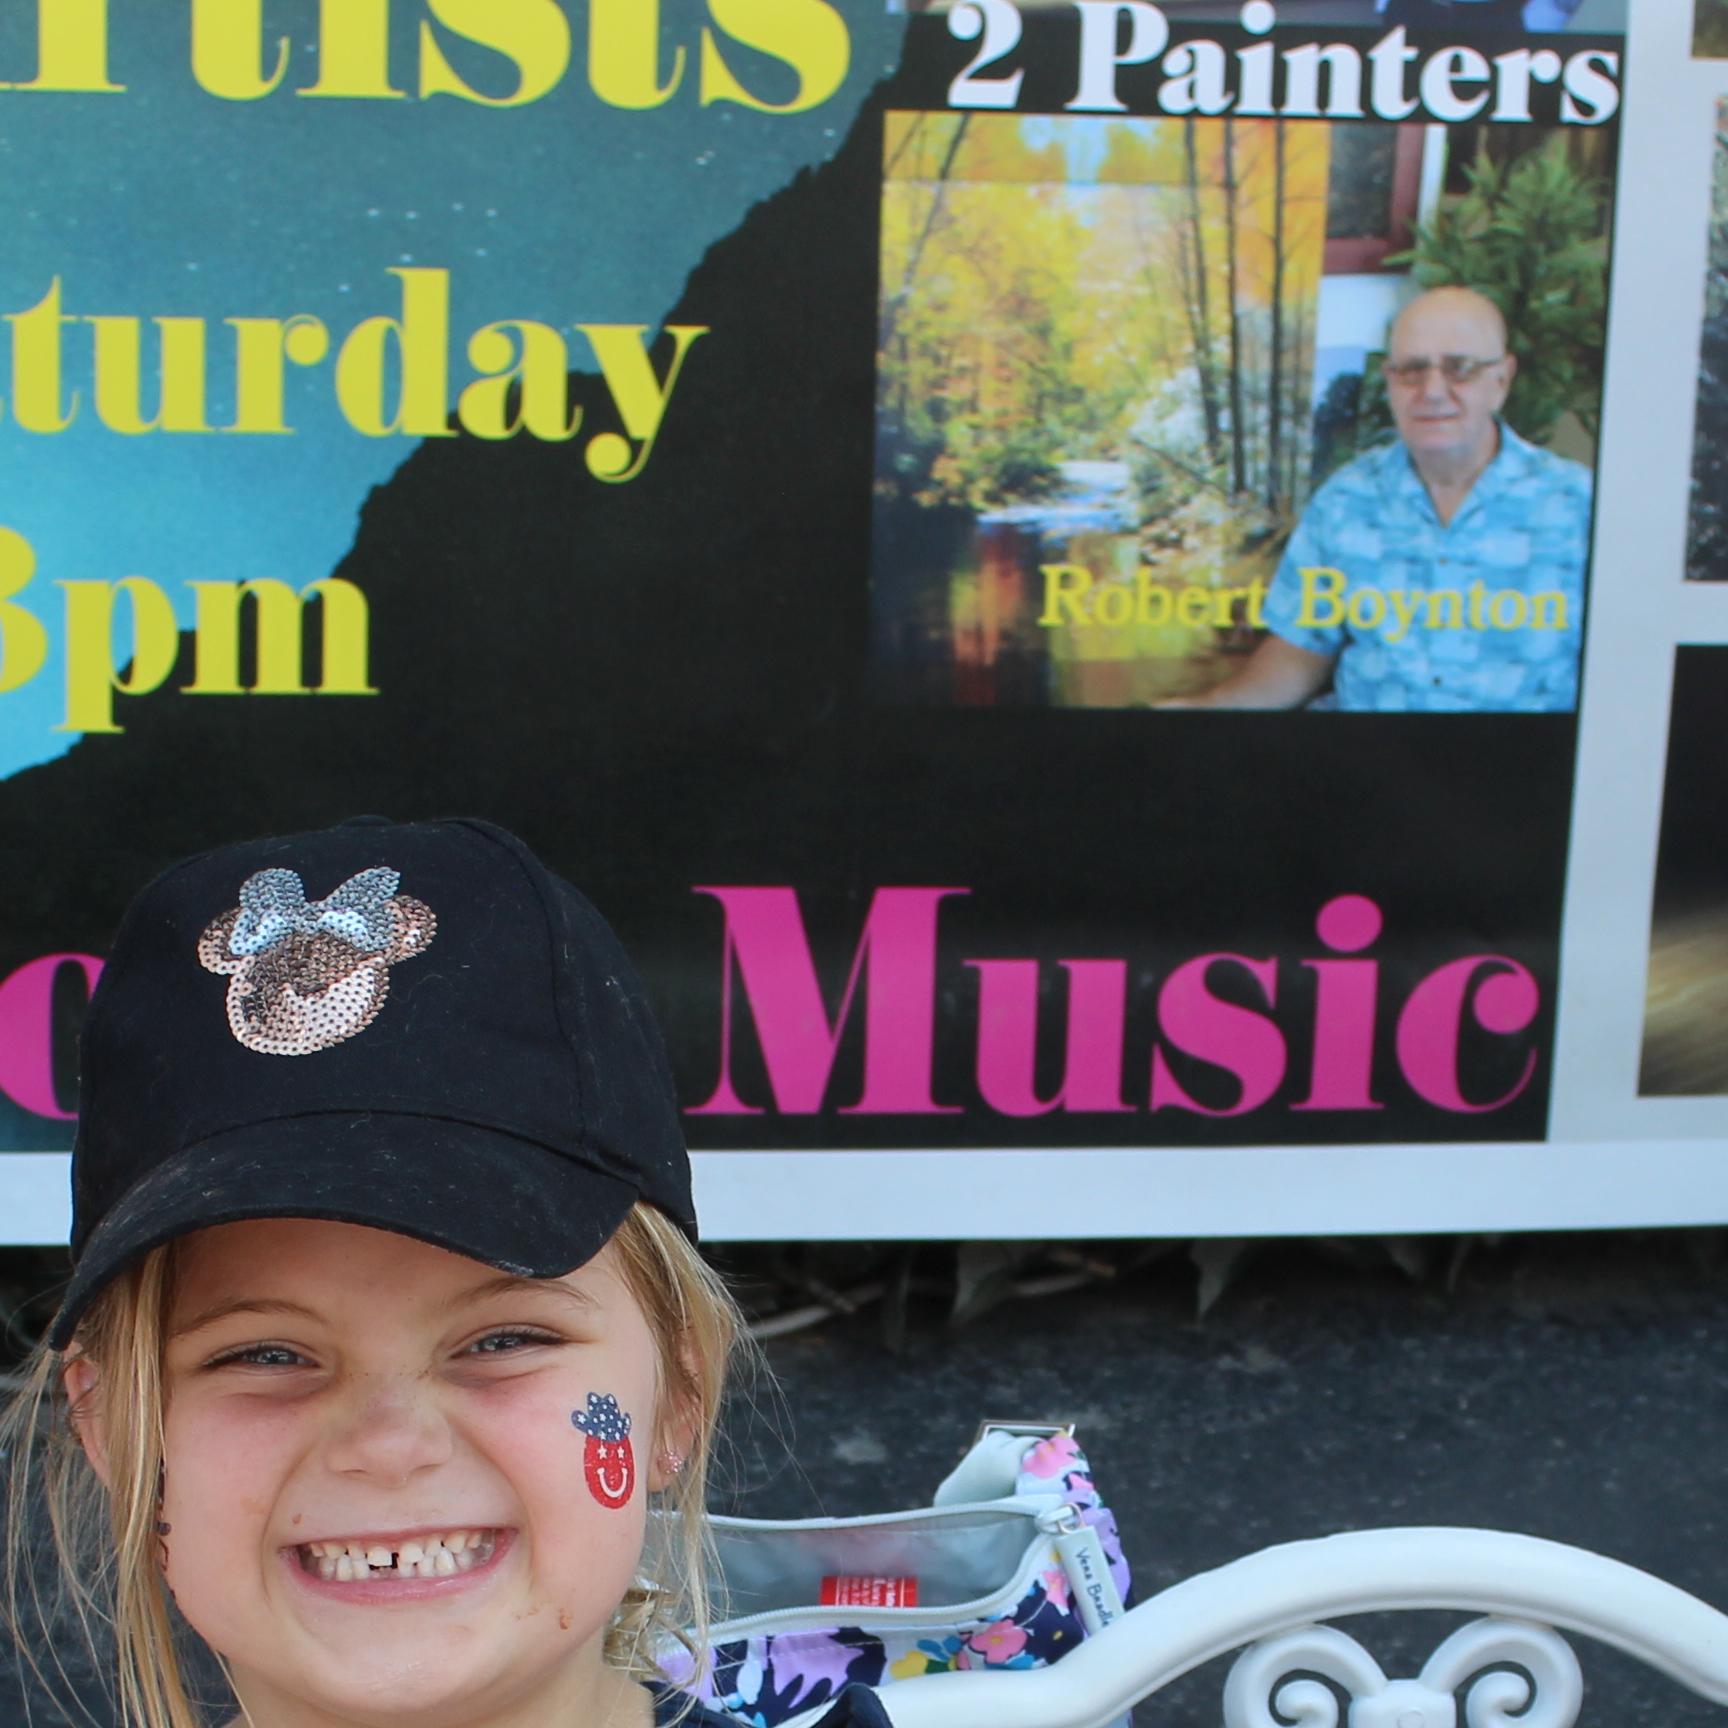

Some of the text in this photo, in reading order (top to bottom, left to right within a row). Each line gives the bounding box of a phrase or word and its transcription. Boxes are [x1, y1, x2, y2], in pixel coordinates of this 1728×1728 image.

[945, 0, 1621, 126] 2 Painters
[1037, 563, 1571, 643] Robert Boynton
[683, 884, 1542, 1118] Music
[1086, 1583, 1114, 1629] Bradle
